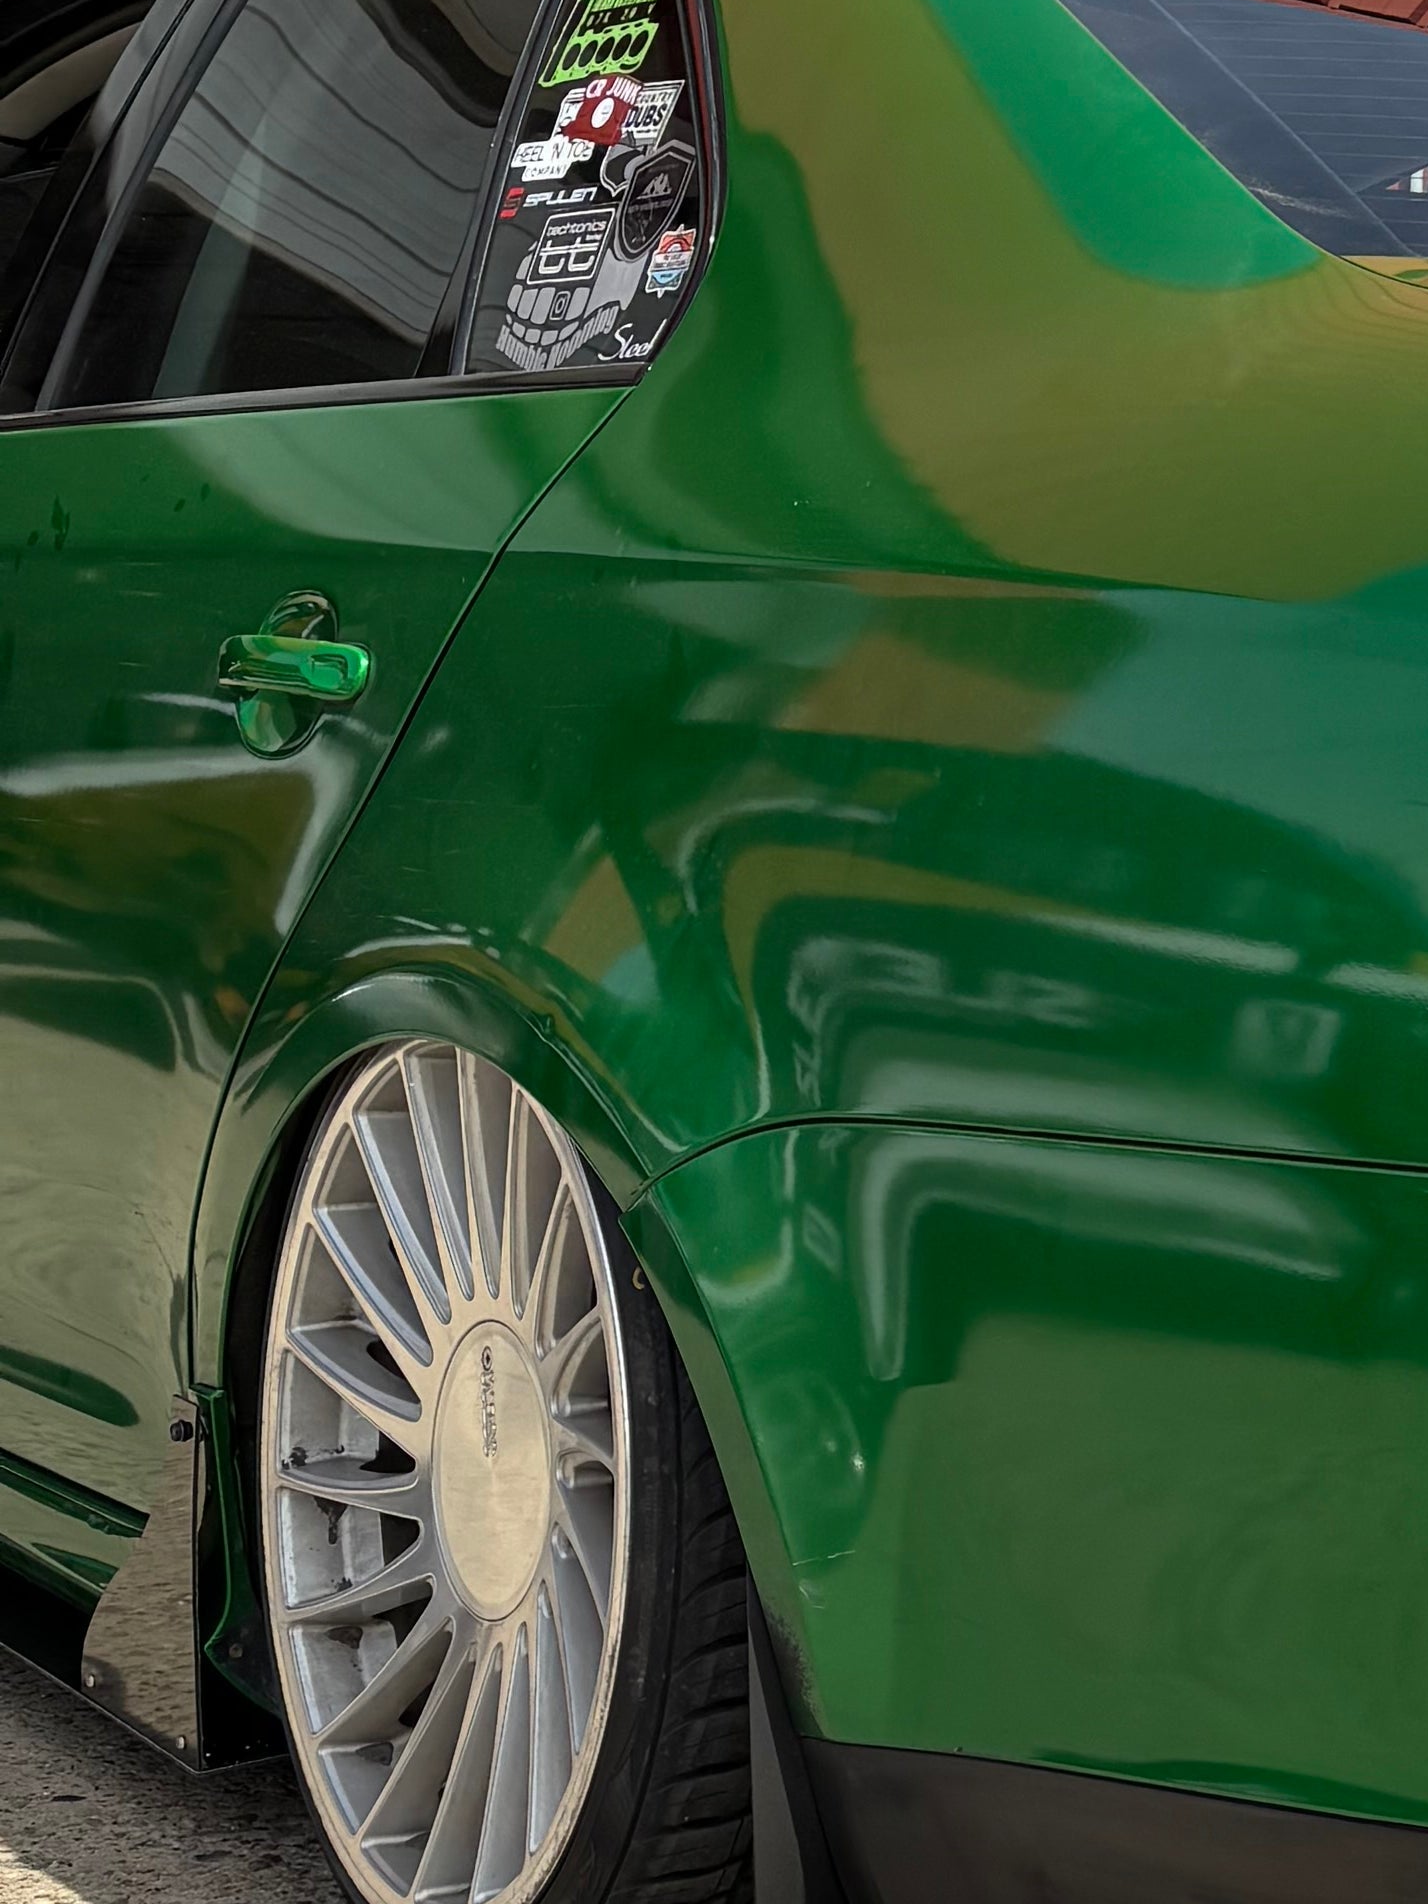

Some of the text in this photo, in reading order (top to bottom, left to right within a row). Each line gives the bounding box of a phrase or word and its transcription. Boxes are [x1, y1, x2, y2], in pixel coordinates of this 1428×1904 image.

[606, 76, 642, 105] JUNK
[625, 103, 668, 128] DUBS
[496, 324, 548, 372] Humble
